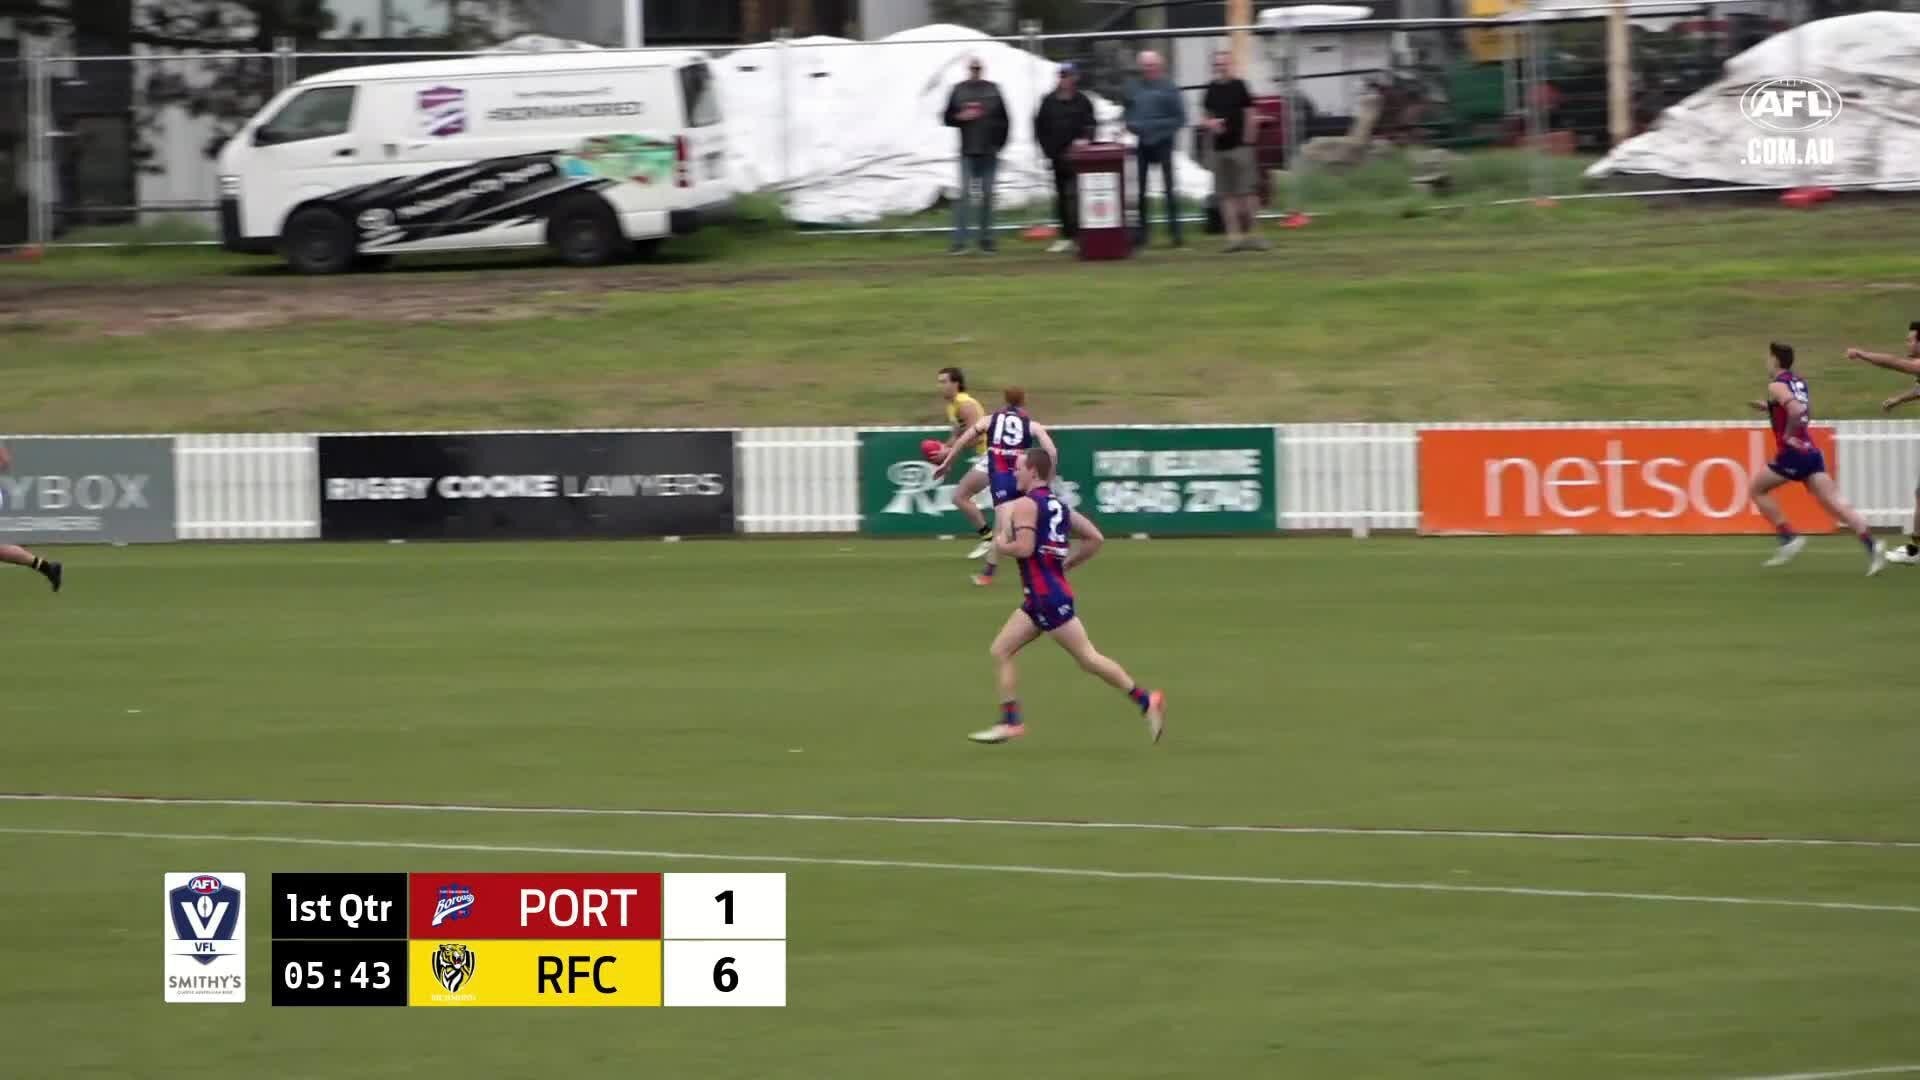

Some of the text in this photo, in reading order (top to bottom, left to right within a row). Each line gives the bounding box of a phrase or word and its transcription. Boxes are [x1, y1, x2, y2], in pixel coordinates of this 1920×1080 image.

[993, 412, 1024, 446] 19
[326, 473, 724, 501] RIGBY COOKE LAWYERS
[1484, 430, 1765, 519] netsol
[1047, 499, 1066, 543] 2
